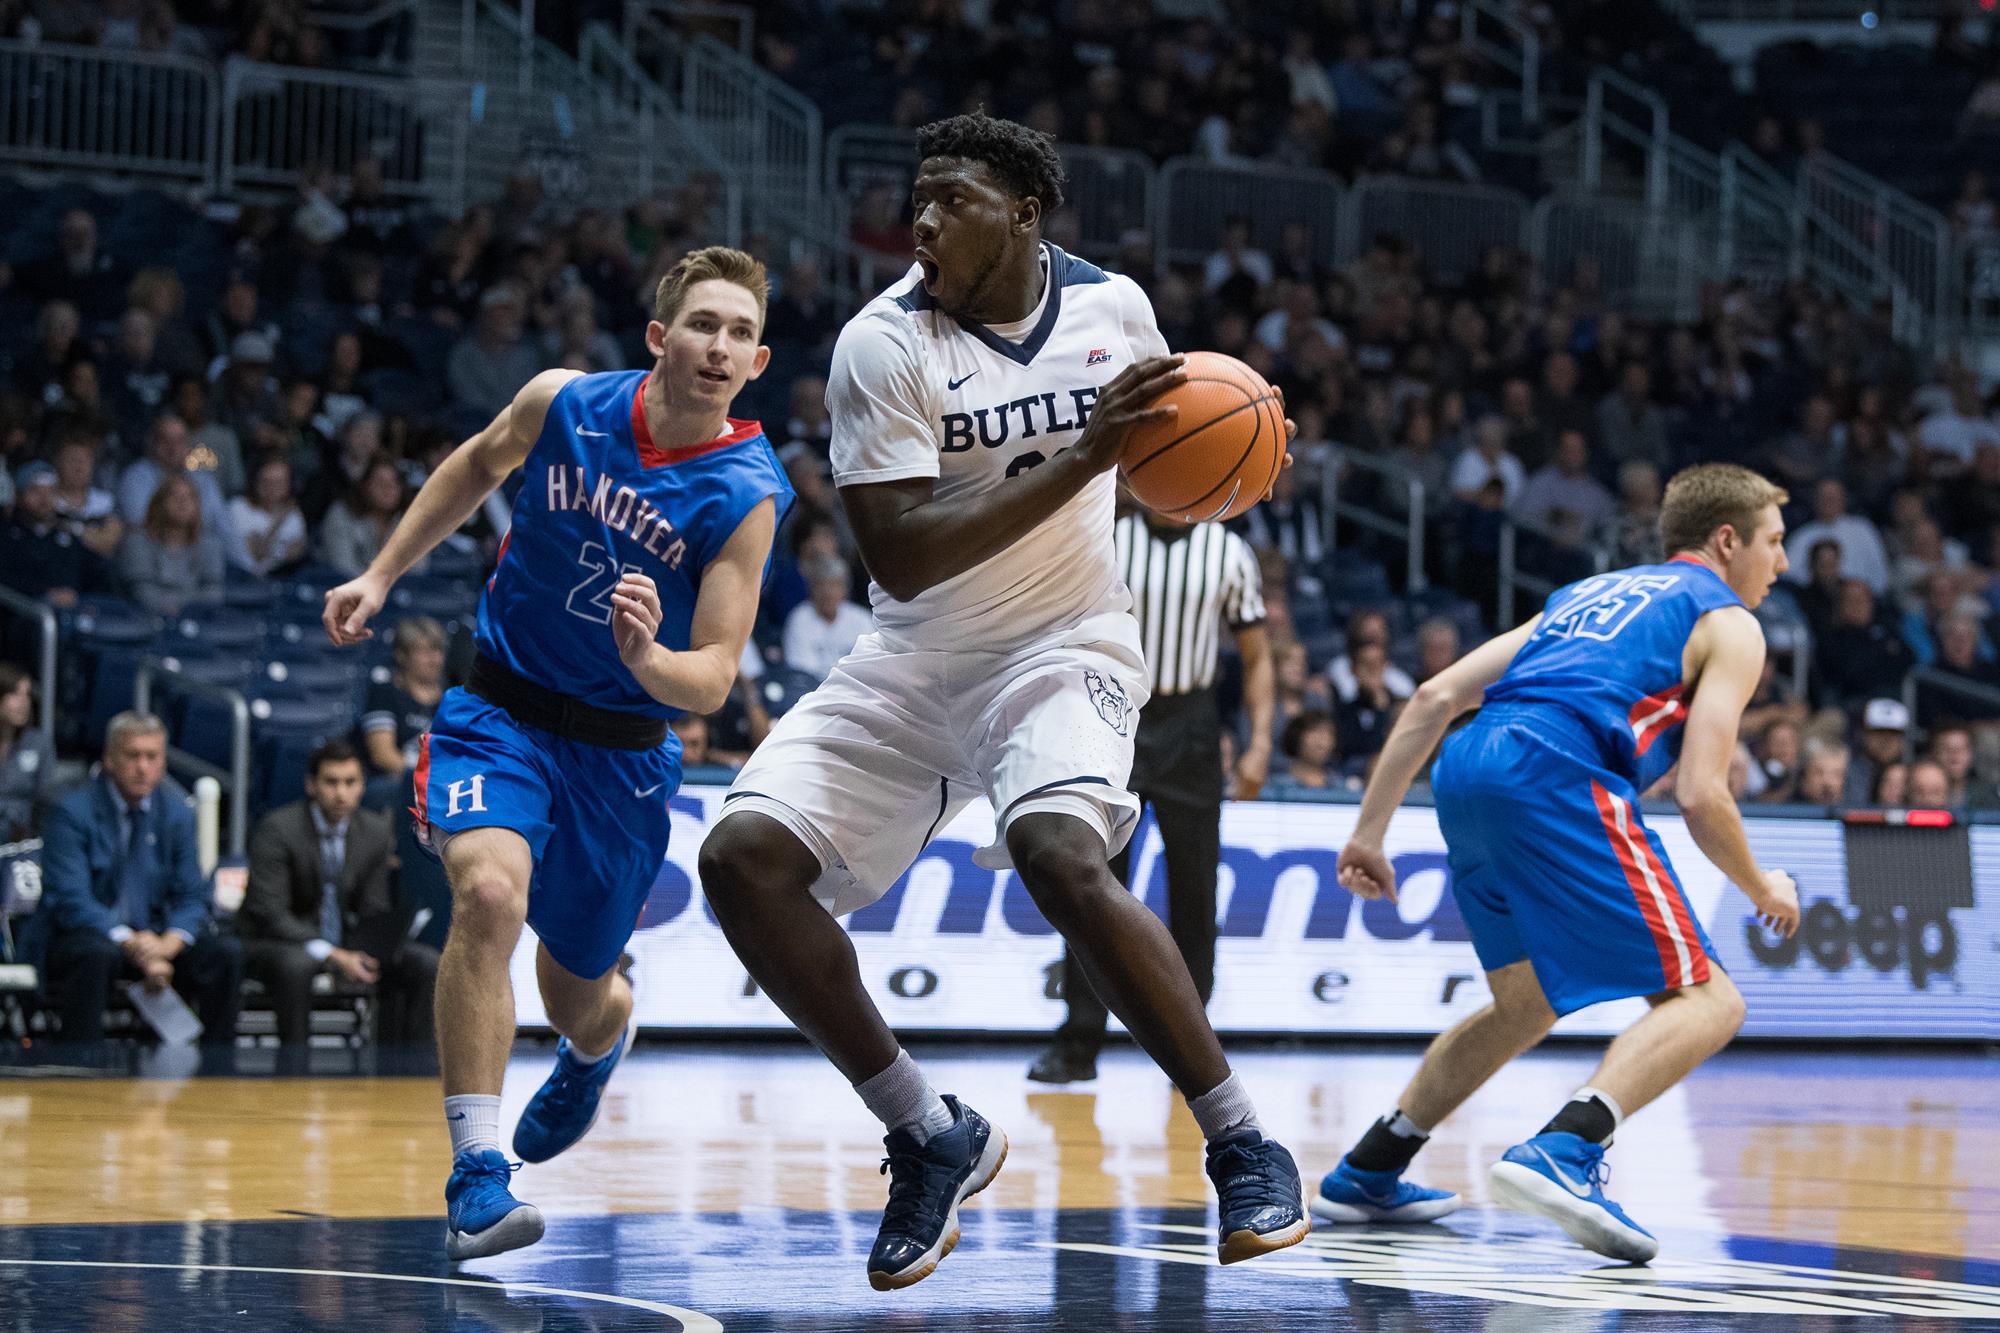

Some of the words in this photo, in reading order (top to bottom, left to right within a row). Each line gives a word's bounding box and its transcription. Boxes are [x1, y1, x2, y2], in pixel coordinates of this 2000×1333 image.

[1087, 355, 1113, 363] EAST
[1090, 348, 1107, 356] BIG
[941, 386, 1105, 453] BUTLE
[565, 540, 643, 626] 2
[445, 773, 488, 818] H
